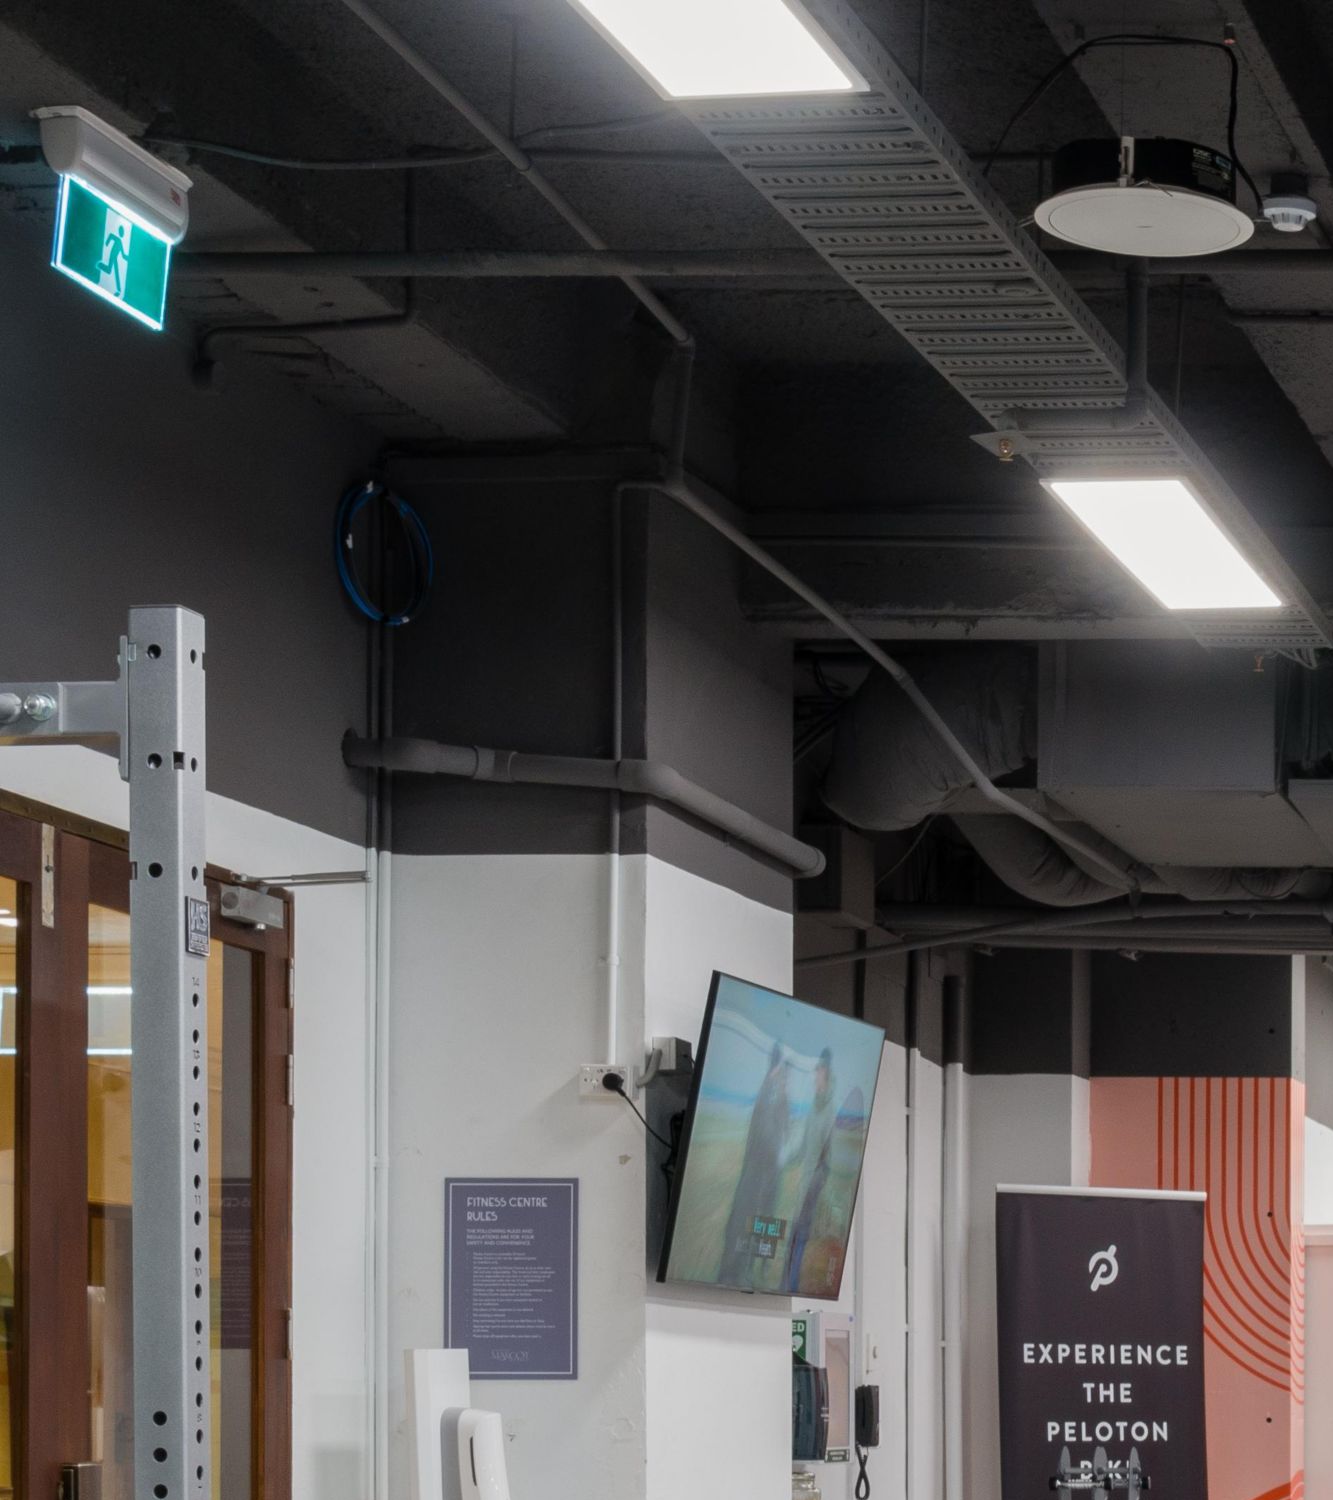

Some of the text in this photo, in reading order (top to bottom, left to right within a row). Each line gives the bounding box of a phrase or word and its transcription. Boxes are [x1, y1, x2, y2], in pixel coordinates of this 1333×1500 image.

[466, 1196, 548, 1208] FITNESS CENTRE
[466, 1210, 498, 1221] RULES
[1022, 1342, 1189, 1366] EXPERIENCE
[1082, 1382, 1133, 1404] THE
[1047, 1421, 1169, 1443] PELOTON
